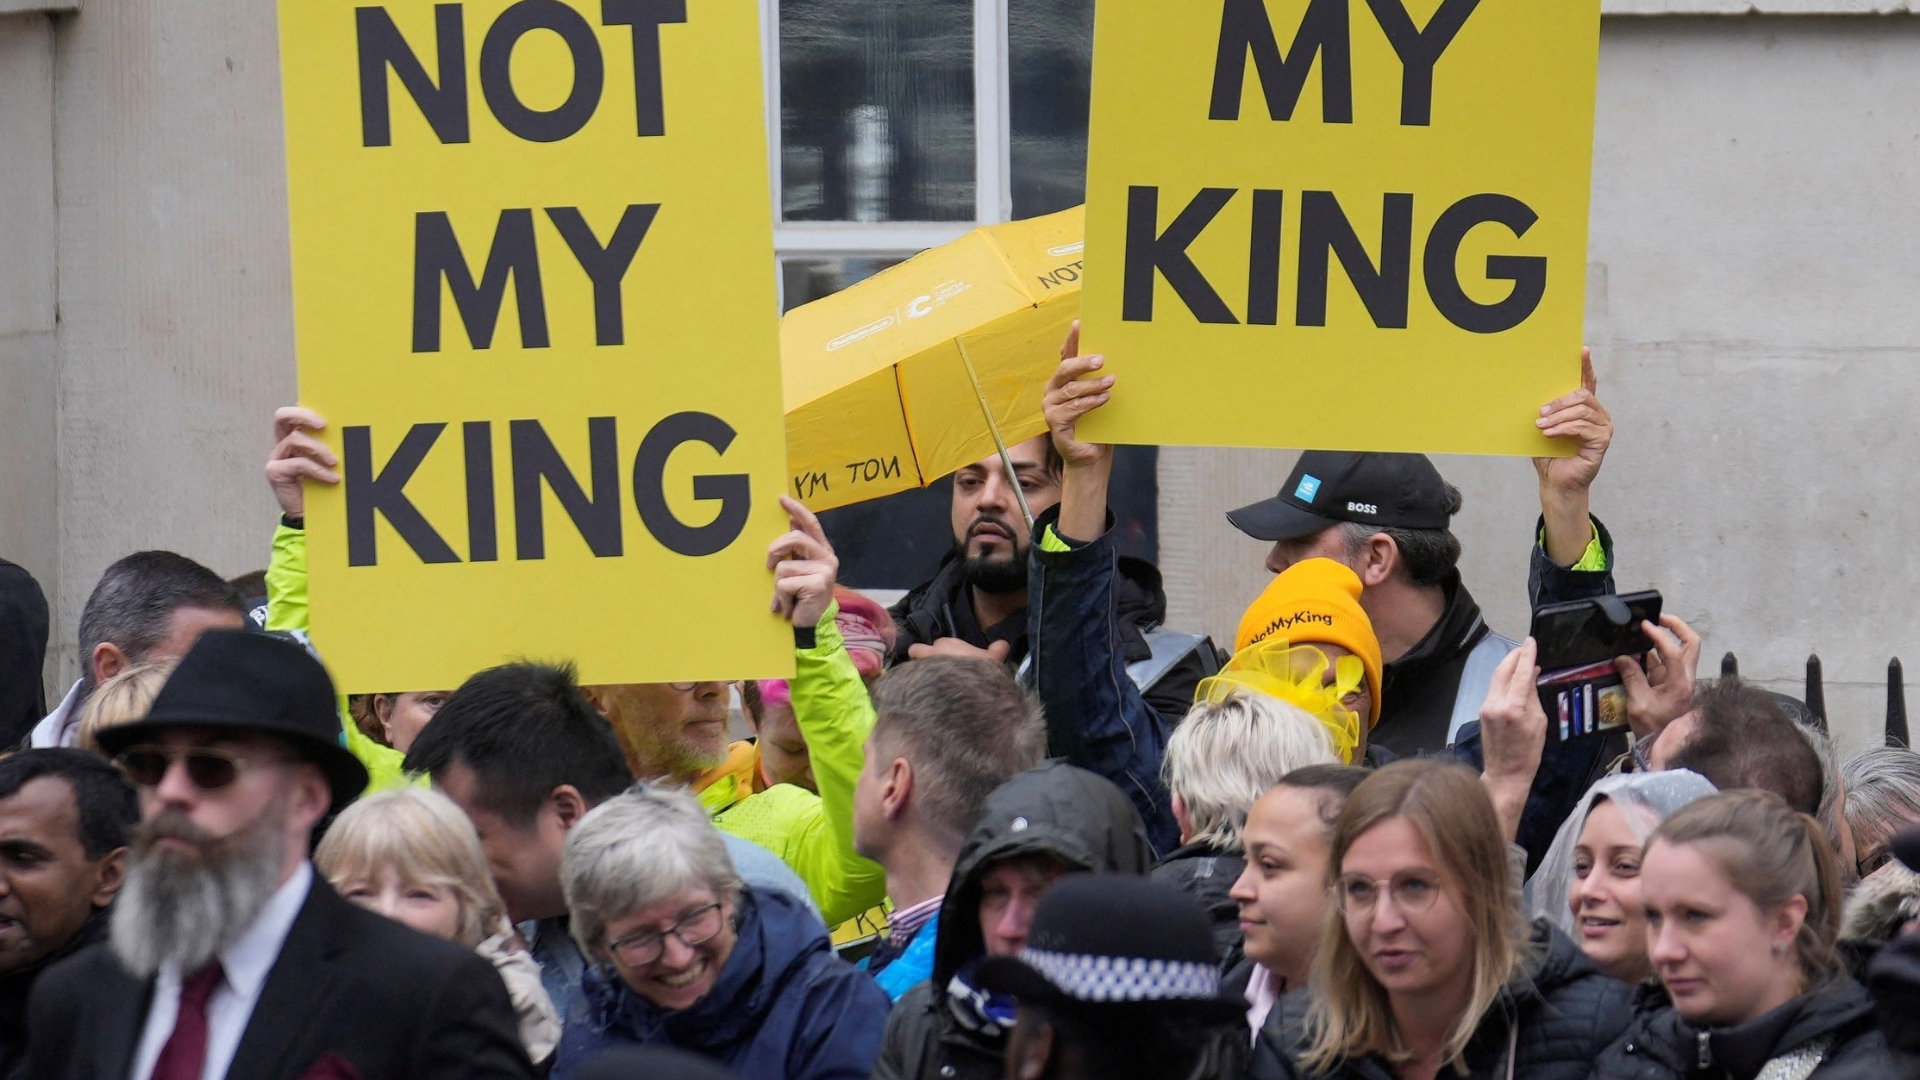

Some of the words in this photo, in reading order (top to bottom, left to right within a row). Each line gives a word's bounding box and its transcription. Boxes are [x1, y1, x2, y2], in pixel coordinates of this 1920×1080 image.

[355, 0, 687, 147] NOT
[1208, 0, 1482, 126] MY
[411, 203, 662, 353] MY
[1121, 185, 1548, 334] KING
[342, 410, 751, 567] KING
[1347, 501, 1378, 514] BOSS
[1248, 611, 1332, 646] NotMyKing
